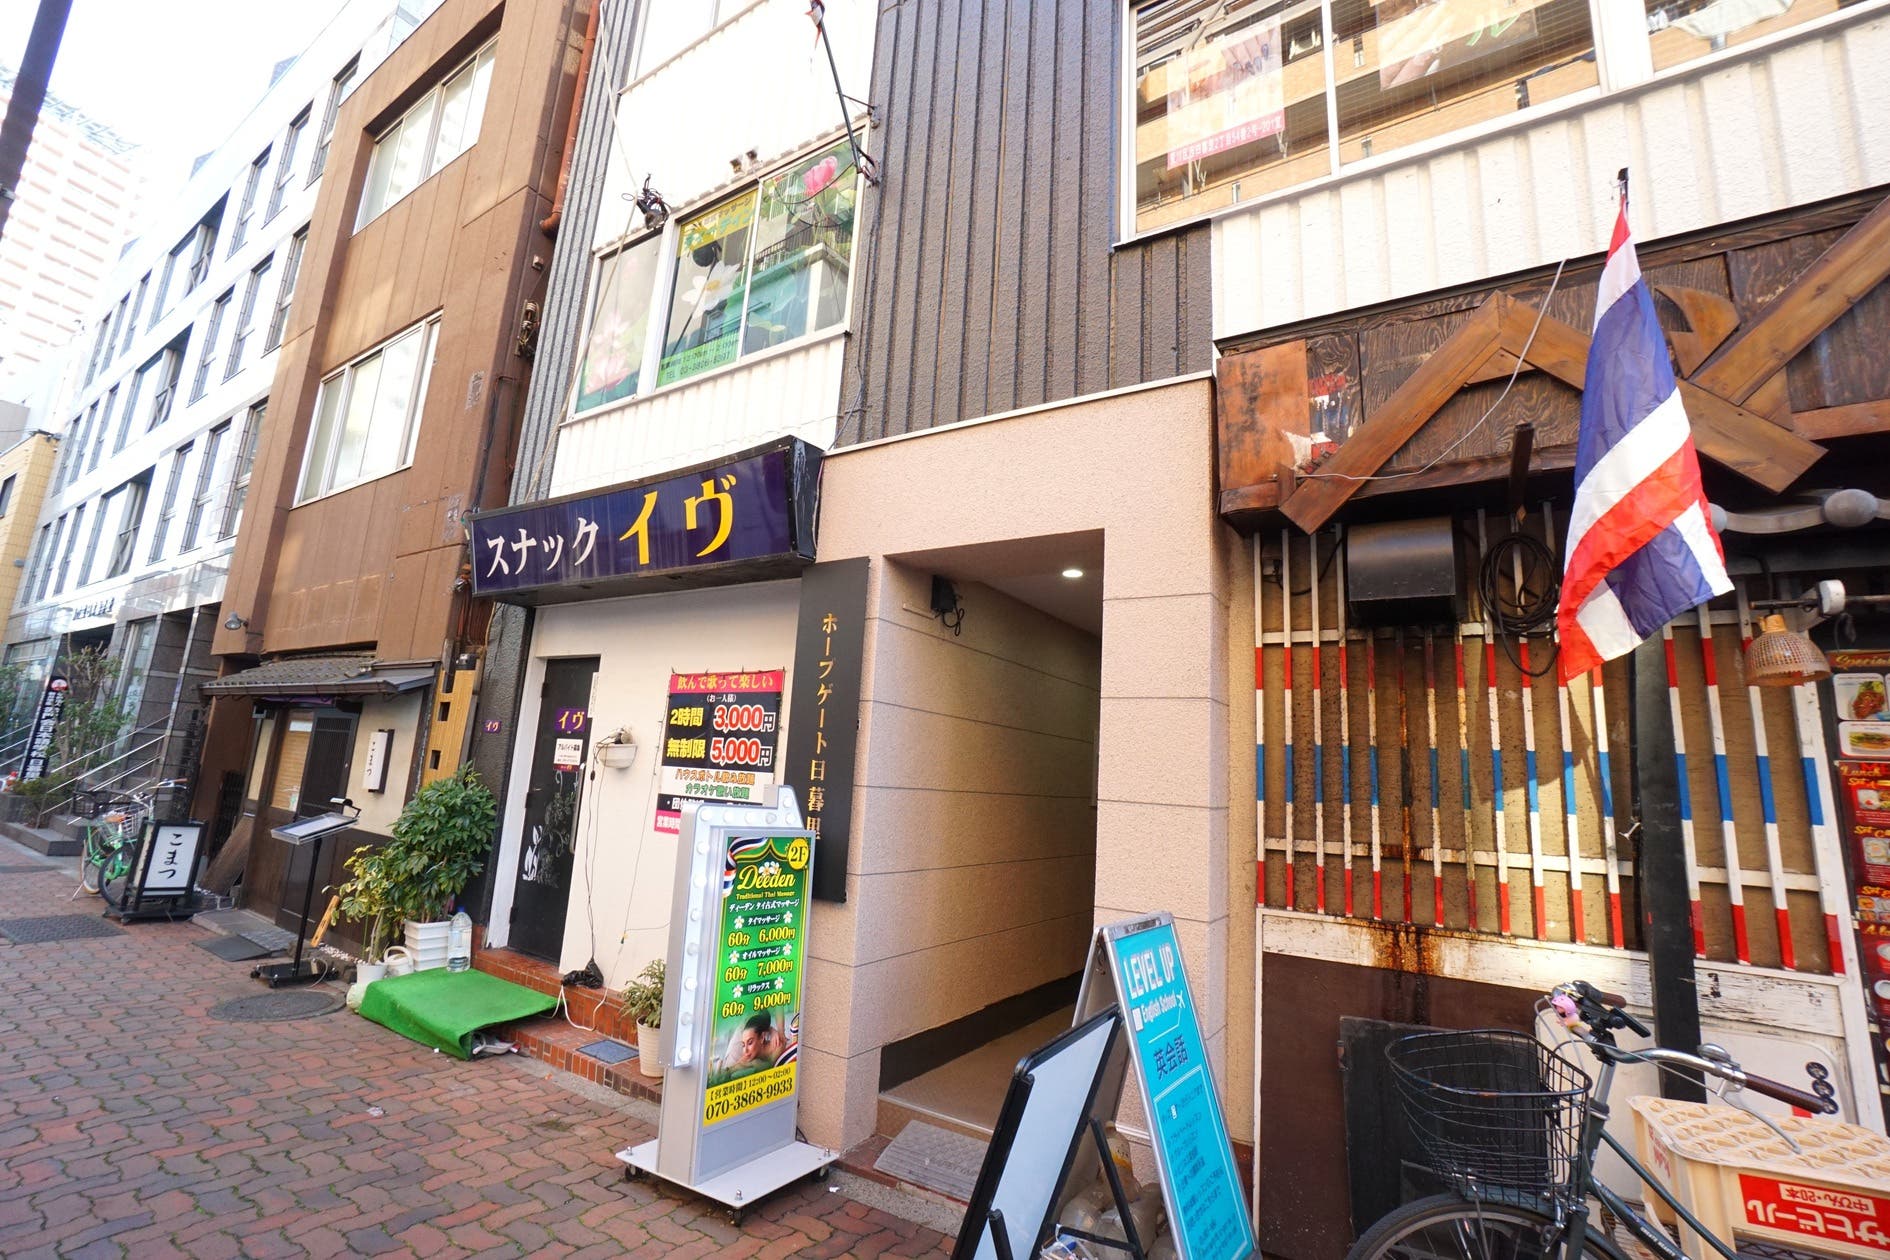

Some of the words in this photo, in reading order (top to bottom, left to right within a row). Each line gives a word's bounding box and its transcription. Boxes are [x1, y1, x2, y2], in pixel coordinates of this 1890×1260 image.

[487, 517, 599, 578] スナック
[619, 474, 737, 565] イヴ
[677, 674, 773, 690] 飲んで歌って楽しい
[558, 711, 585, 730] イヴ
[670, 707, 704, 727] 2時間
[713, 705, 776, 733] 3,000円
[667, 738, 706, 759] 無制限
[710, 737, 773, 767] 5,000円
[158, 833, 183, 879] こまつ
[790, 846, 808, 862] 2F
[737, 864, 796, 890] Deeden
[748, 914, 780, 926] タイマッサージ
[728, 932, 750, 946] 60分
[759, 926, 795, 943] 6,000円
[742, 947, 780, 960] オイルマッサージ
[725, 966, 747, 982] 60分
[757, 959, 793, 977] 7,000円
[1123, 948, 1163, 1000] LEVEL
[1159, 942, 1175, 983] UP
[747, 982, 770, 993] リラックス
[722, 1001, 744, 1018] 60分
[753, 991, 791, 1010] 9,000円
[1141, 999, 1161, 1023] English
[1160, 990, 1178, 1013] School
[1154, 1035, 1189, 1080] 英会話
[705, 1078, 792, 1120] 070-3868-9933
